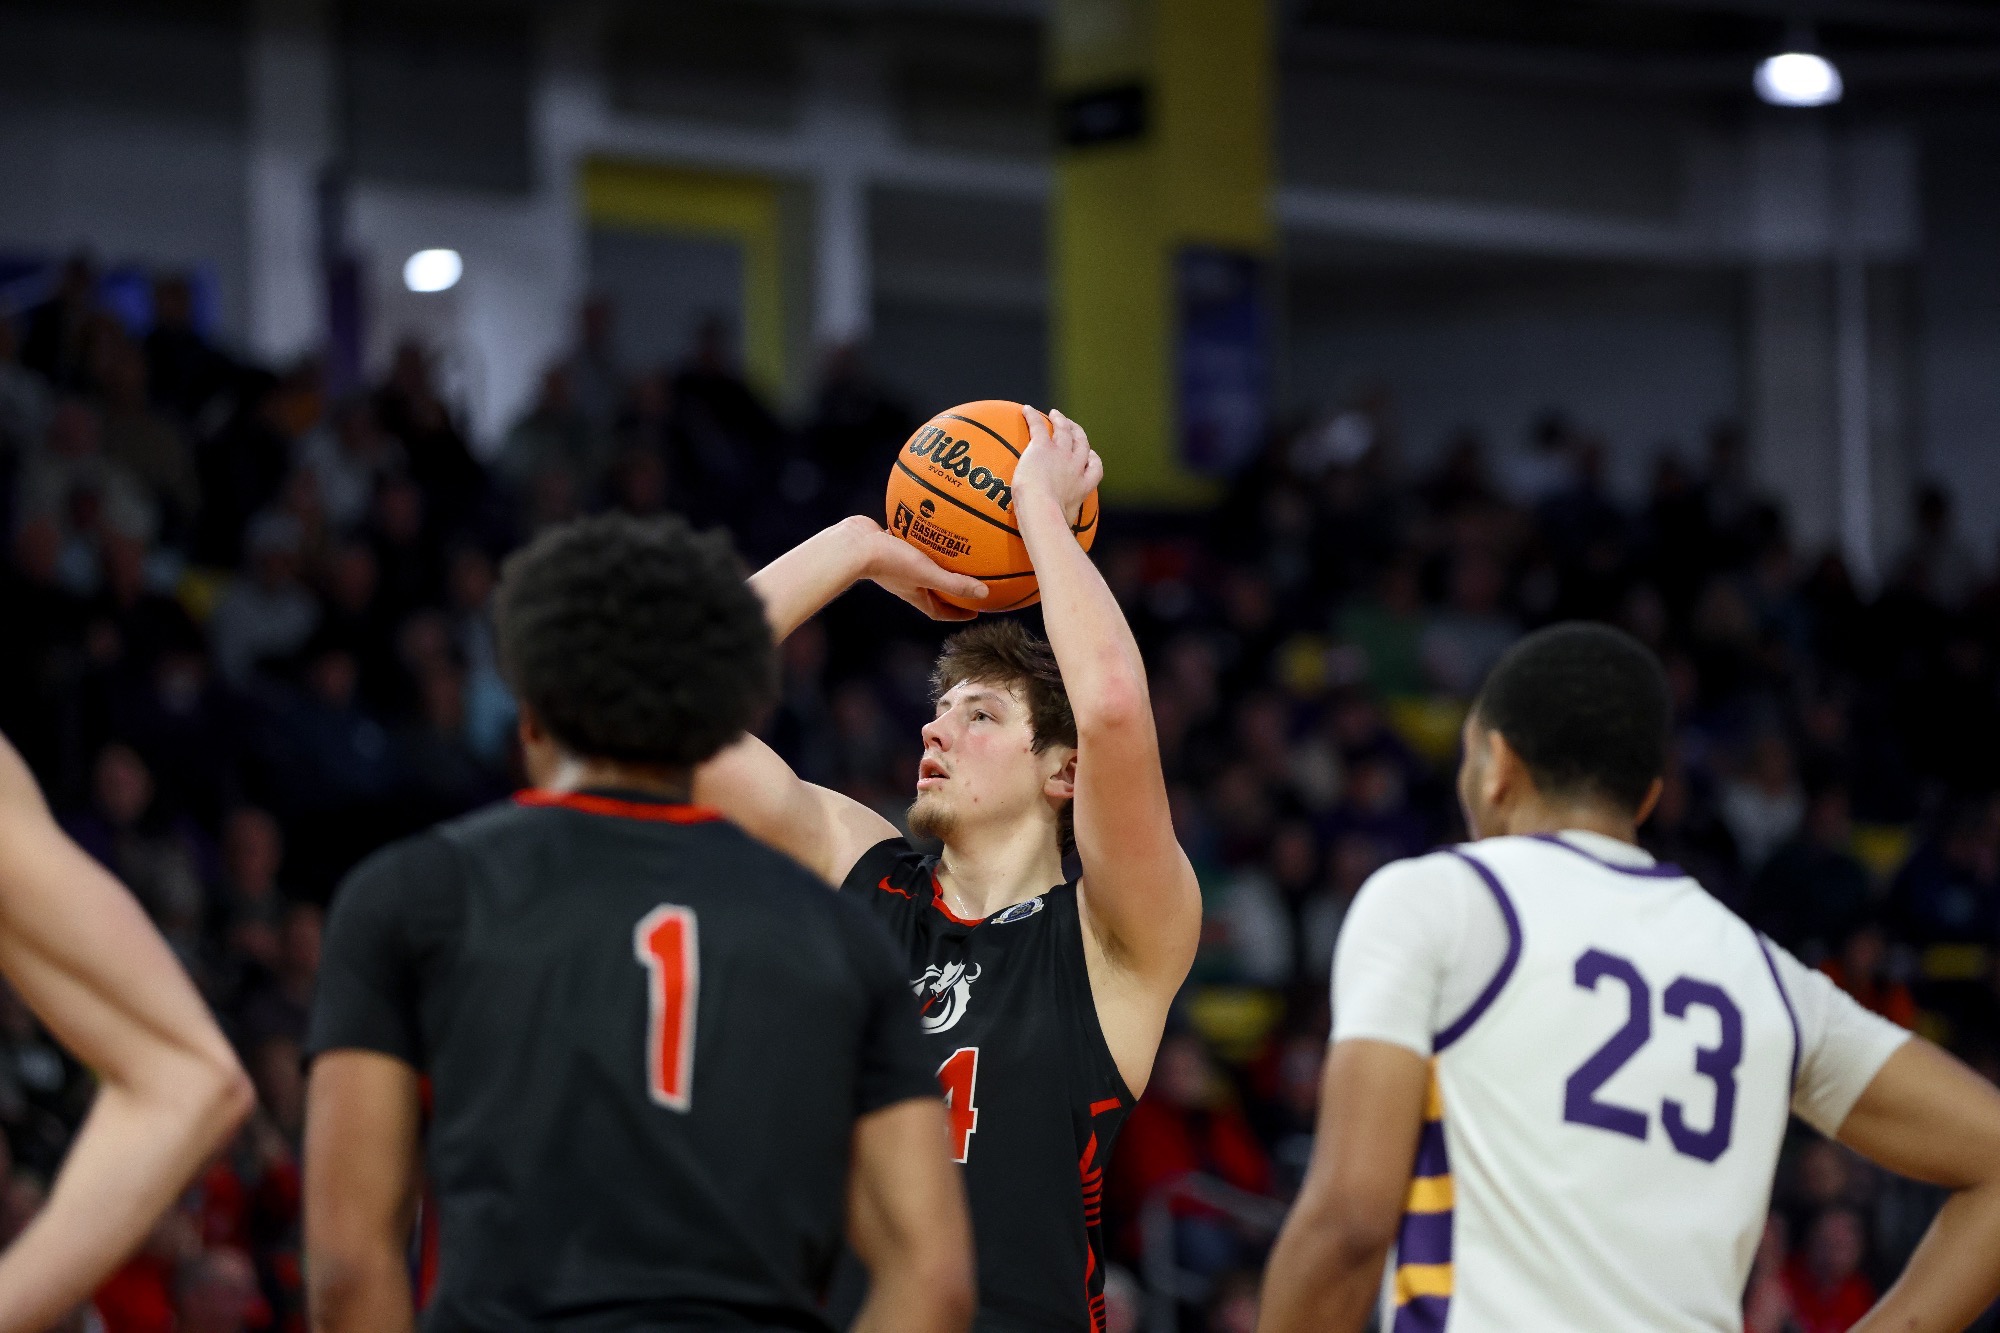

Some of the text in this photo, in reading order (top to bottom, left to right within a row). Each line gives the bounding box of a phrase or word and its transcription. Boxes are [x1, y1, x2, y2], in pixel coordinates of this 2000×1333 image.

[909, 425, 1013, 511] Wilson
[928, 465, 963, 488] EVO NXT
[910, 530, 959, 557] CHAMPIONSHIP
[913, 520, 971, 555] BASKETBALL
[632, 902, 700, 1114] 1
[1562, 946, 1744, 1164] 23
